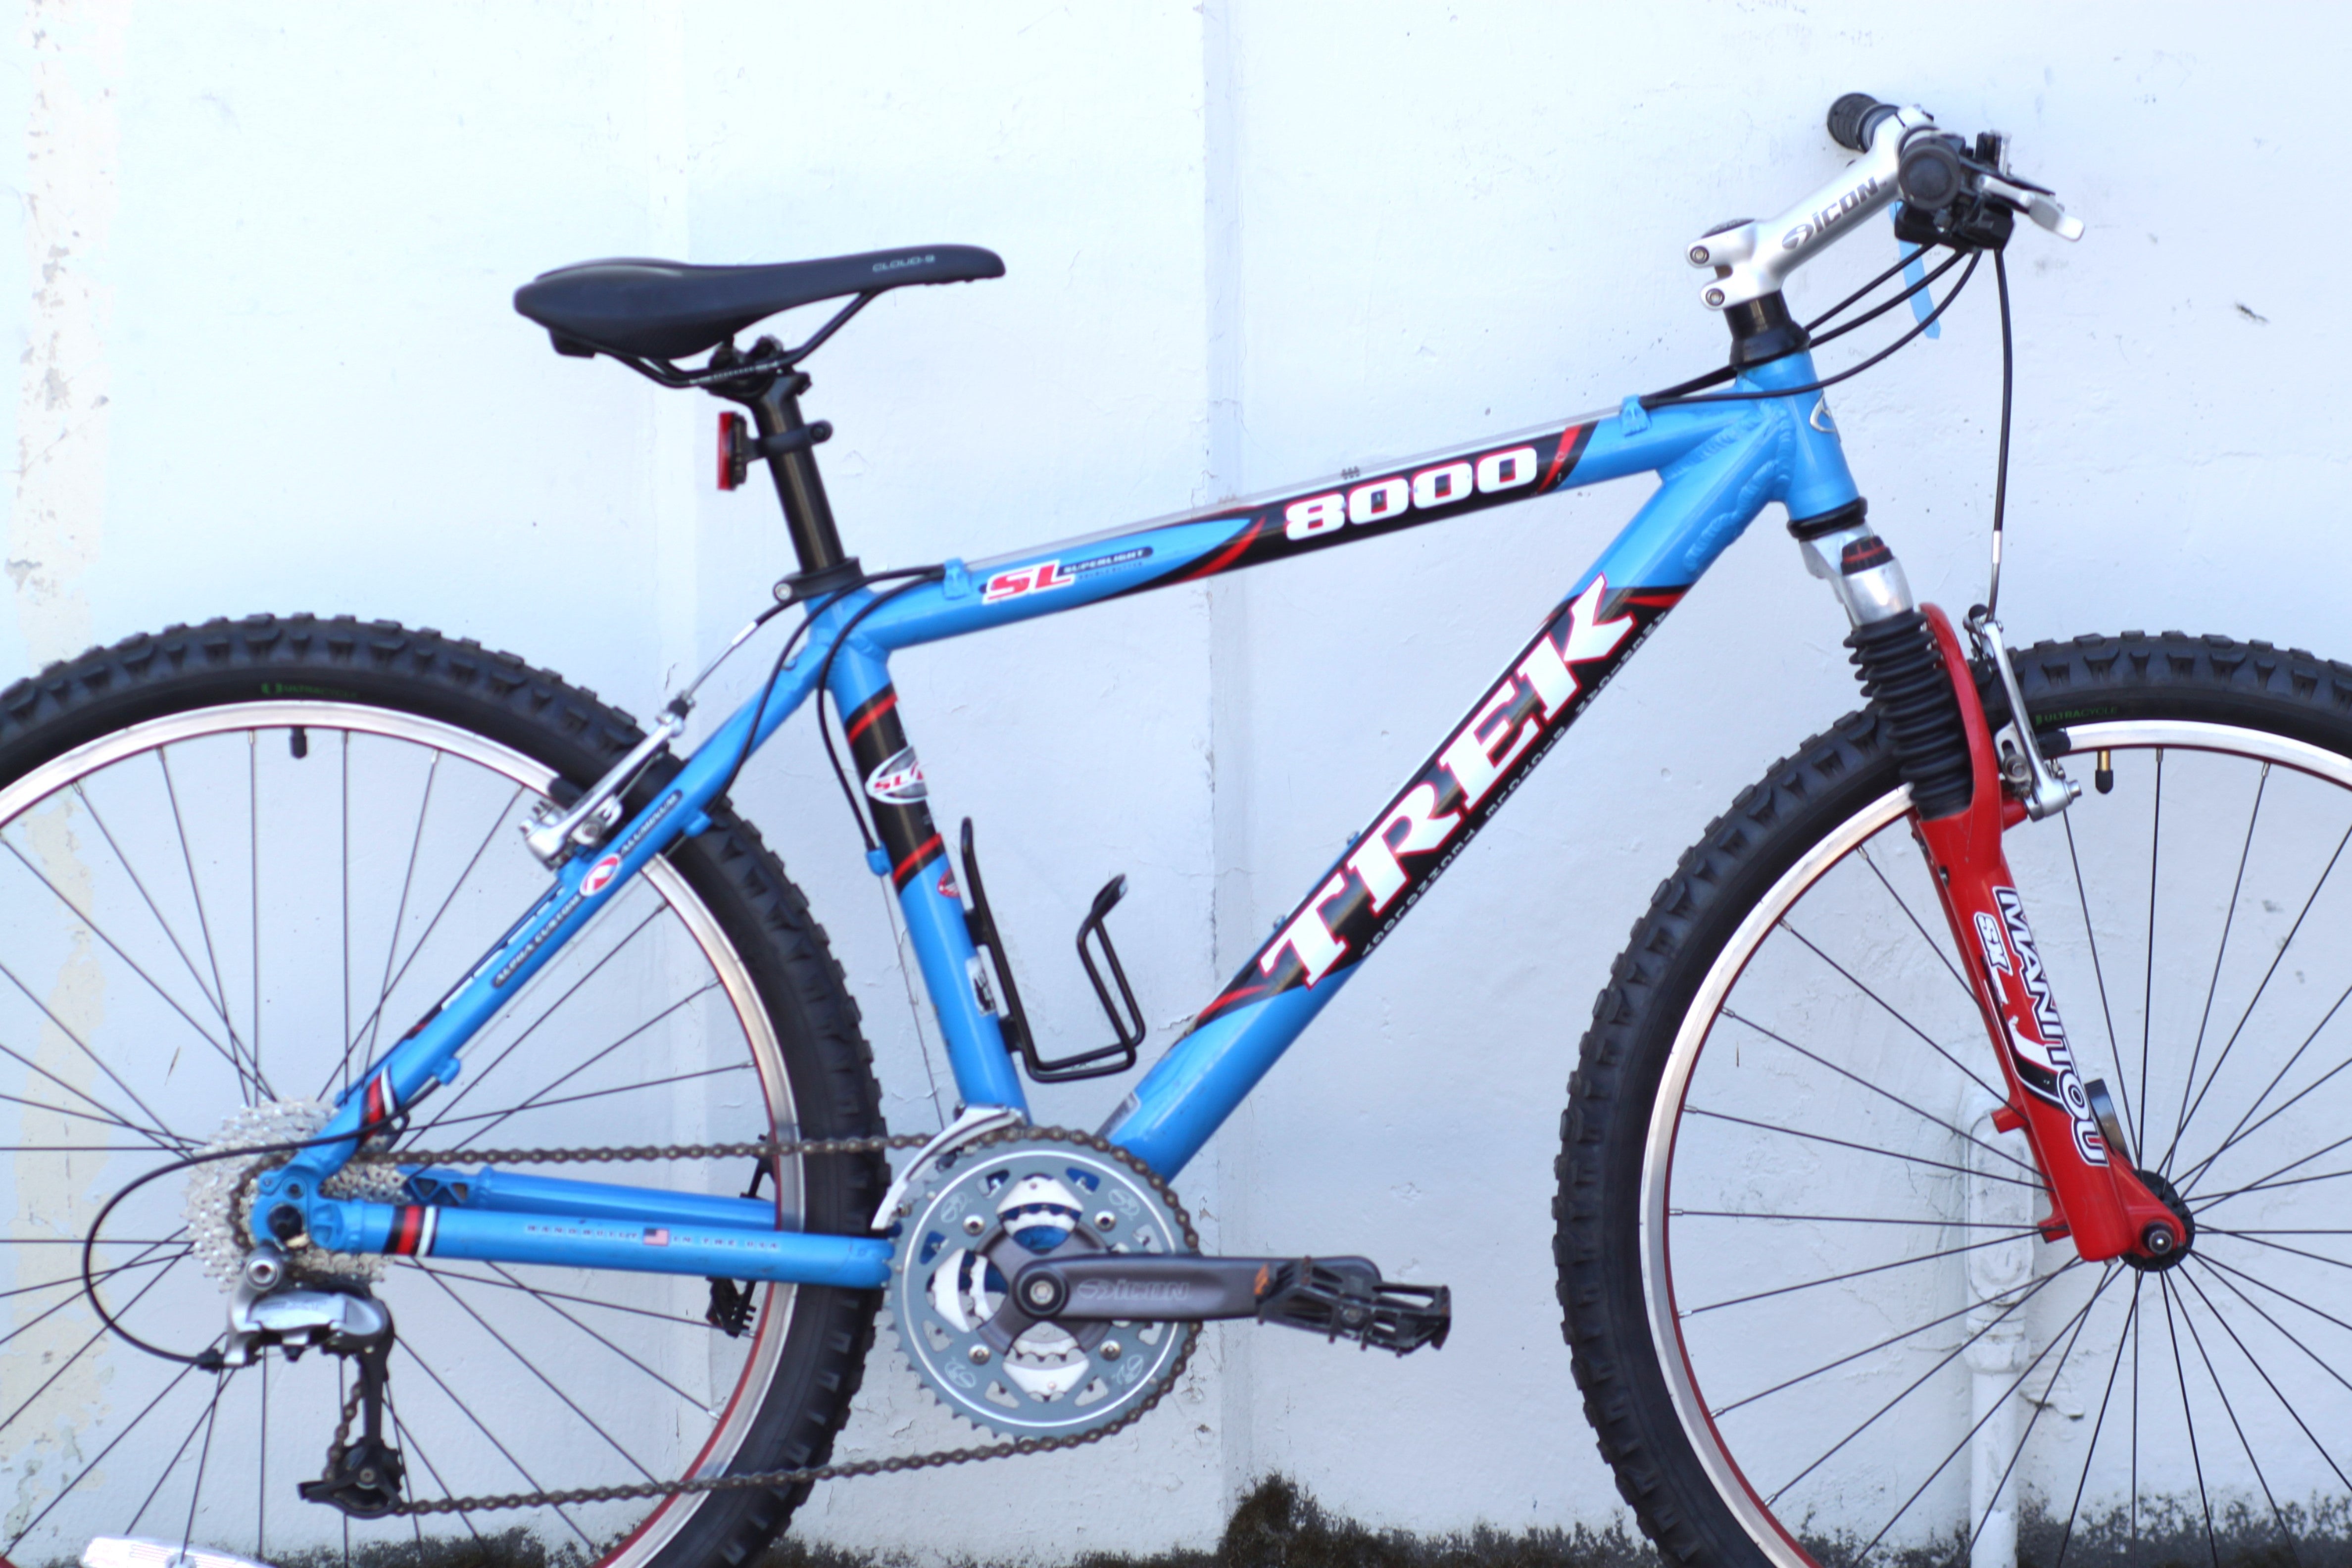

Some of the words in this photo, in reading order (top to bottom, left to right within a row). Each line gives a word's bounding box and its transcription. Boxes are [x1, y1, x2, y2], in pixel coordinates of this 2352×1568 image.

[1284, 444, 1537, 541] 8000
[982, 560, 1076, 604] SL
[1064, 549, 1145, 573] SUPERLIGHT
[1576, 611, 1666, 714] AMERICAN
[2044, 705, 2118, 723] ULTRACYCLE
[1258, 572, 1638, 990] TREK
[1485, 725, 1566, 818] BICYCLE
[495, 944, 534, 985] ALPHA
[534, 896, 581, 943] CUSTOM
[620, 794, 678, 856] ALUMINUM
[1362, 828, 1476, 957] TECHNOLOGY
[1974, 912, 2012, 976] SX
[1993, 886, 2109, 1167] MANITOU
[702, 1237, 736, 1247] THE
